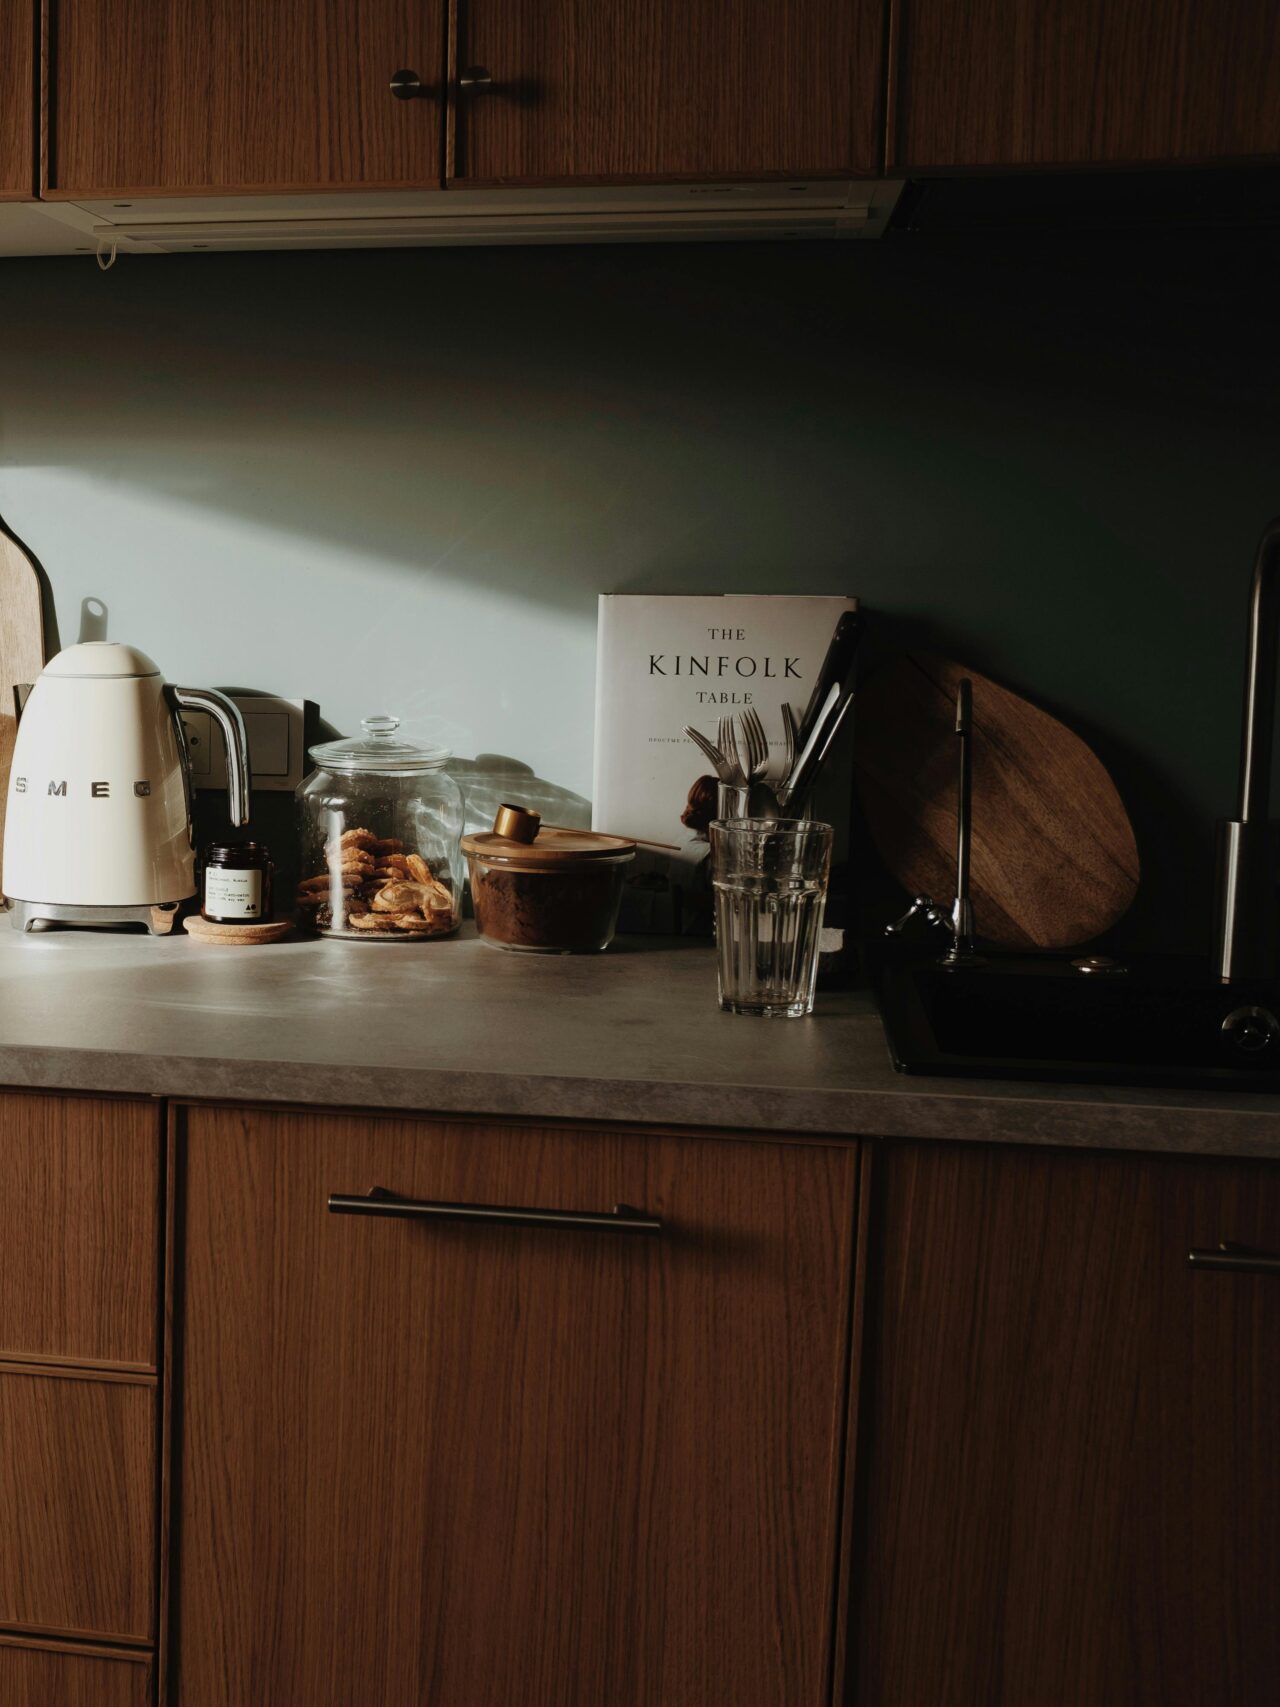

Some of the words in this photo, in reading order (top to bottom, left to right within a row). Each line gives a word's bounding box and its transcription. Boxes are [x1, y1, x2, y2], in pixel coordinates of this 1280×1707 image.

[707, 628, 746, 641] THE
[648, 654, 803, 679] KINFOLK
[695, 691, 754, 705] TABLE
[15, 776, 151, 799] SMEG
